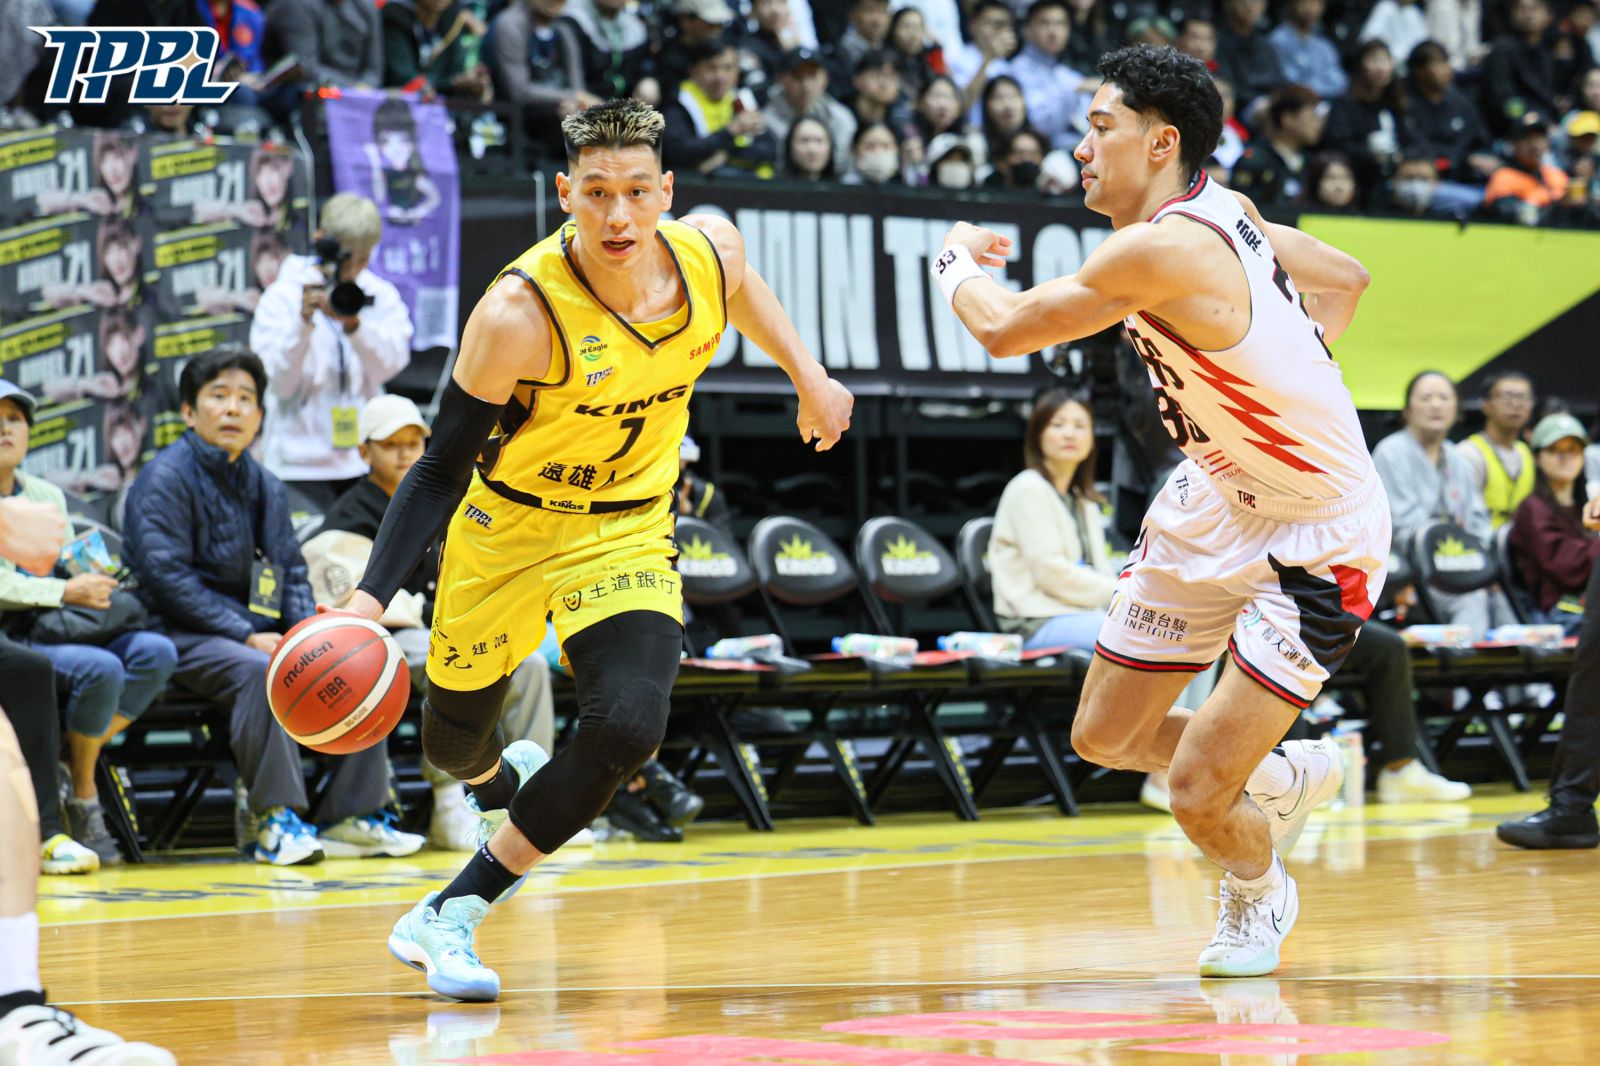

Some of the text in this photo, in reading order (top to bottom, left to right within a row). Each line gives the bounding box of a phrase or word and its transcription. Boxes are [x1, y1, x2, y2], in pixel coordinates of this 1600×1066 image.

[936, 250, 957, 275] 33
[588, 343, 608, 354] Eagle
[602, 416, 646, 463] 7
[538, 462, 634, 491] 遠雄人
[464, 503, 494, 531] TPBL
[549, 499, 585, 512] KINGS
[588, 571, 676, 601] 王道銀行
[1124, 617, 1184, 643] INFINITE
[1127, 603, 1188, 633] 日盛台駿
[283, 639, 334, 689] molten
[316, 676, 347, 704] FIBA
